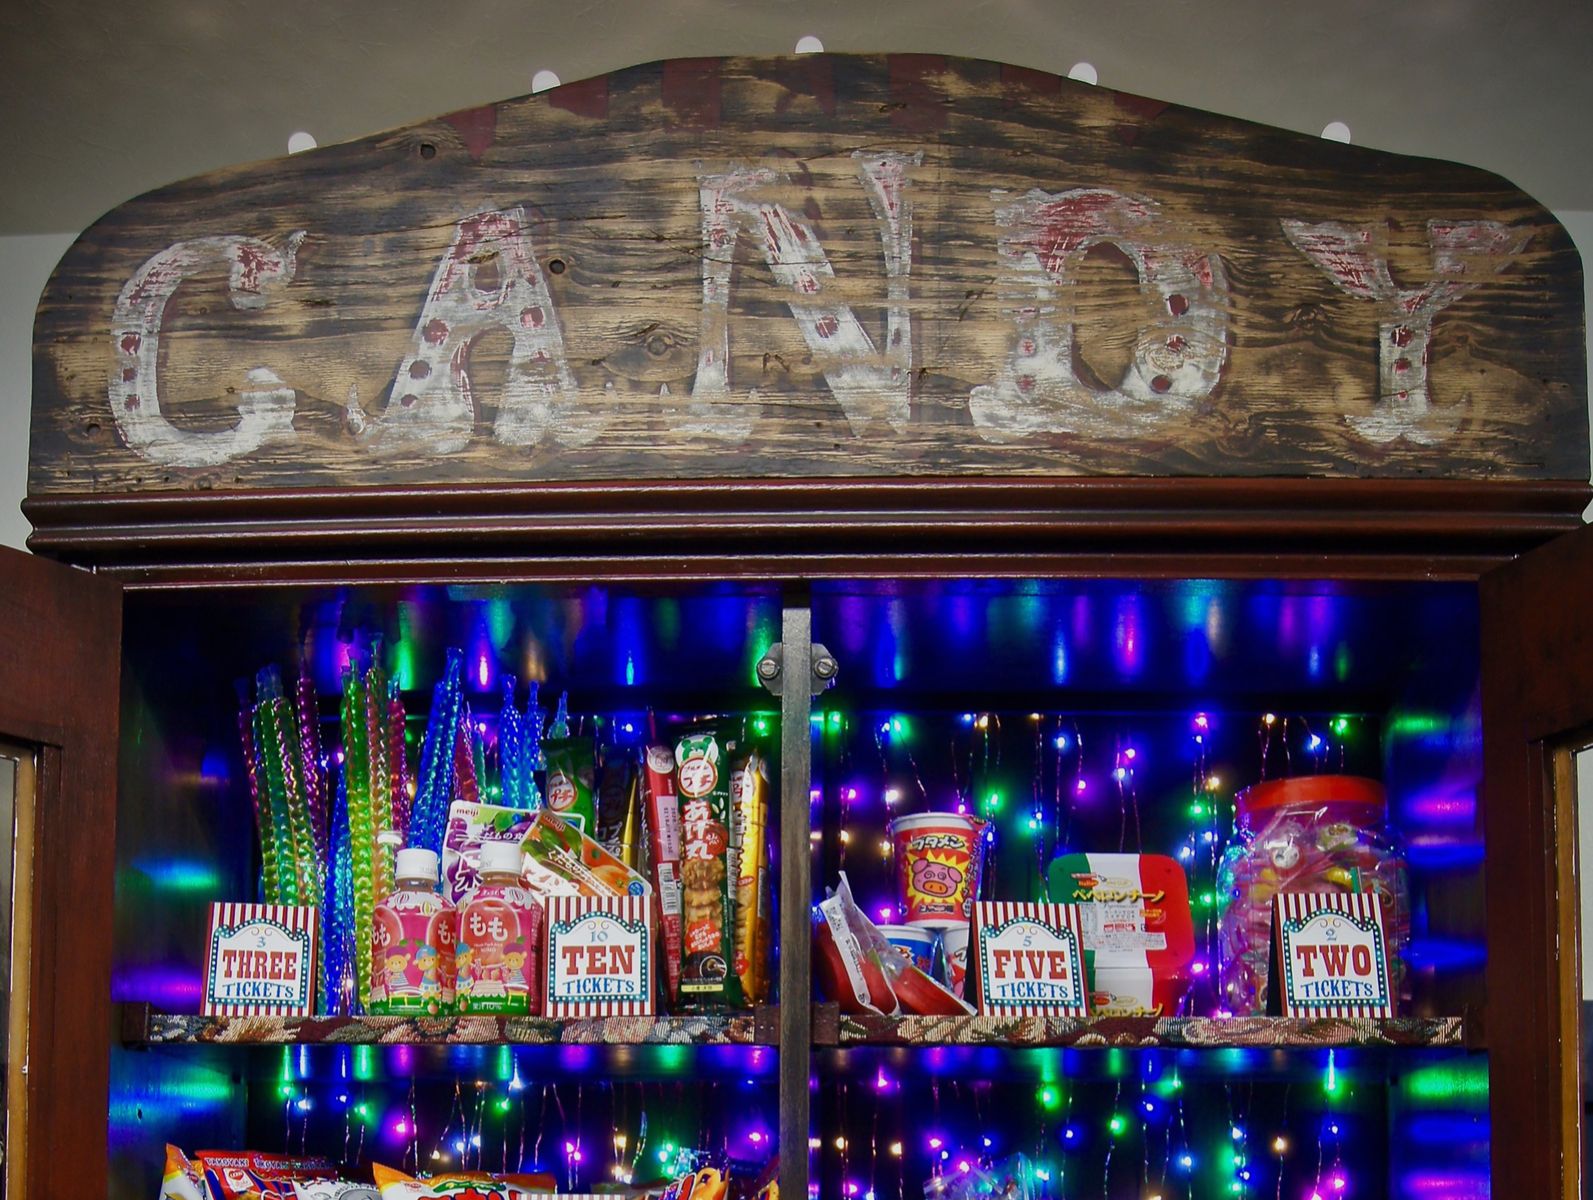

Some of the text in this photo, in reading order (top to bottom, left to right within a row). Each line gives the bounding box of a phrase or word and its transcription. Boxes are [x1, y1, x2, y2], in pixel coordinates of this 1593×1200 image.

[109, 151, 1535, 467] CANDY
[456, 807, 479, 817] meiji
[544, 814, 566, 832] meiji
[912, 834, 966, 851] ブタメン
[469, 912, 508, 942] もも
[1324, 928, 1338, 941] 2
[256, 936, 266, 948] 3
[590, 931, 608, 942] 10
[1022, 935, 1032, 947] 5
[222, 949, 297, 980] THREE
[562, 945, 635, 975] TEN
[993, 949, 1068, 980] FIVE
[1296, 944, 1372, 976] TWO
[222, 981, 294, 998] TICKETS
[563, 976, 634, 994] TICKETS
[996, 981, 1069, 998] TICKETS
[1300, 979, 1373, 998] TICKETS
